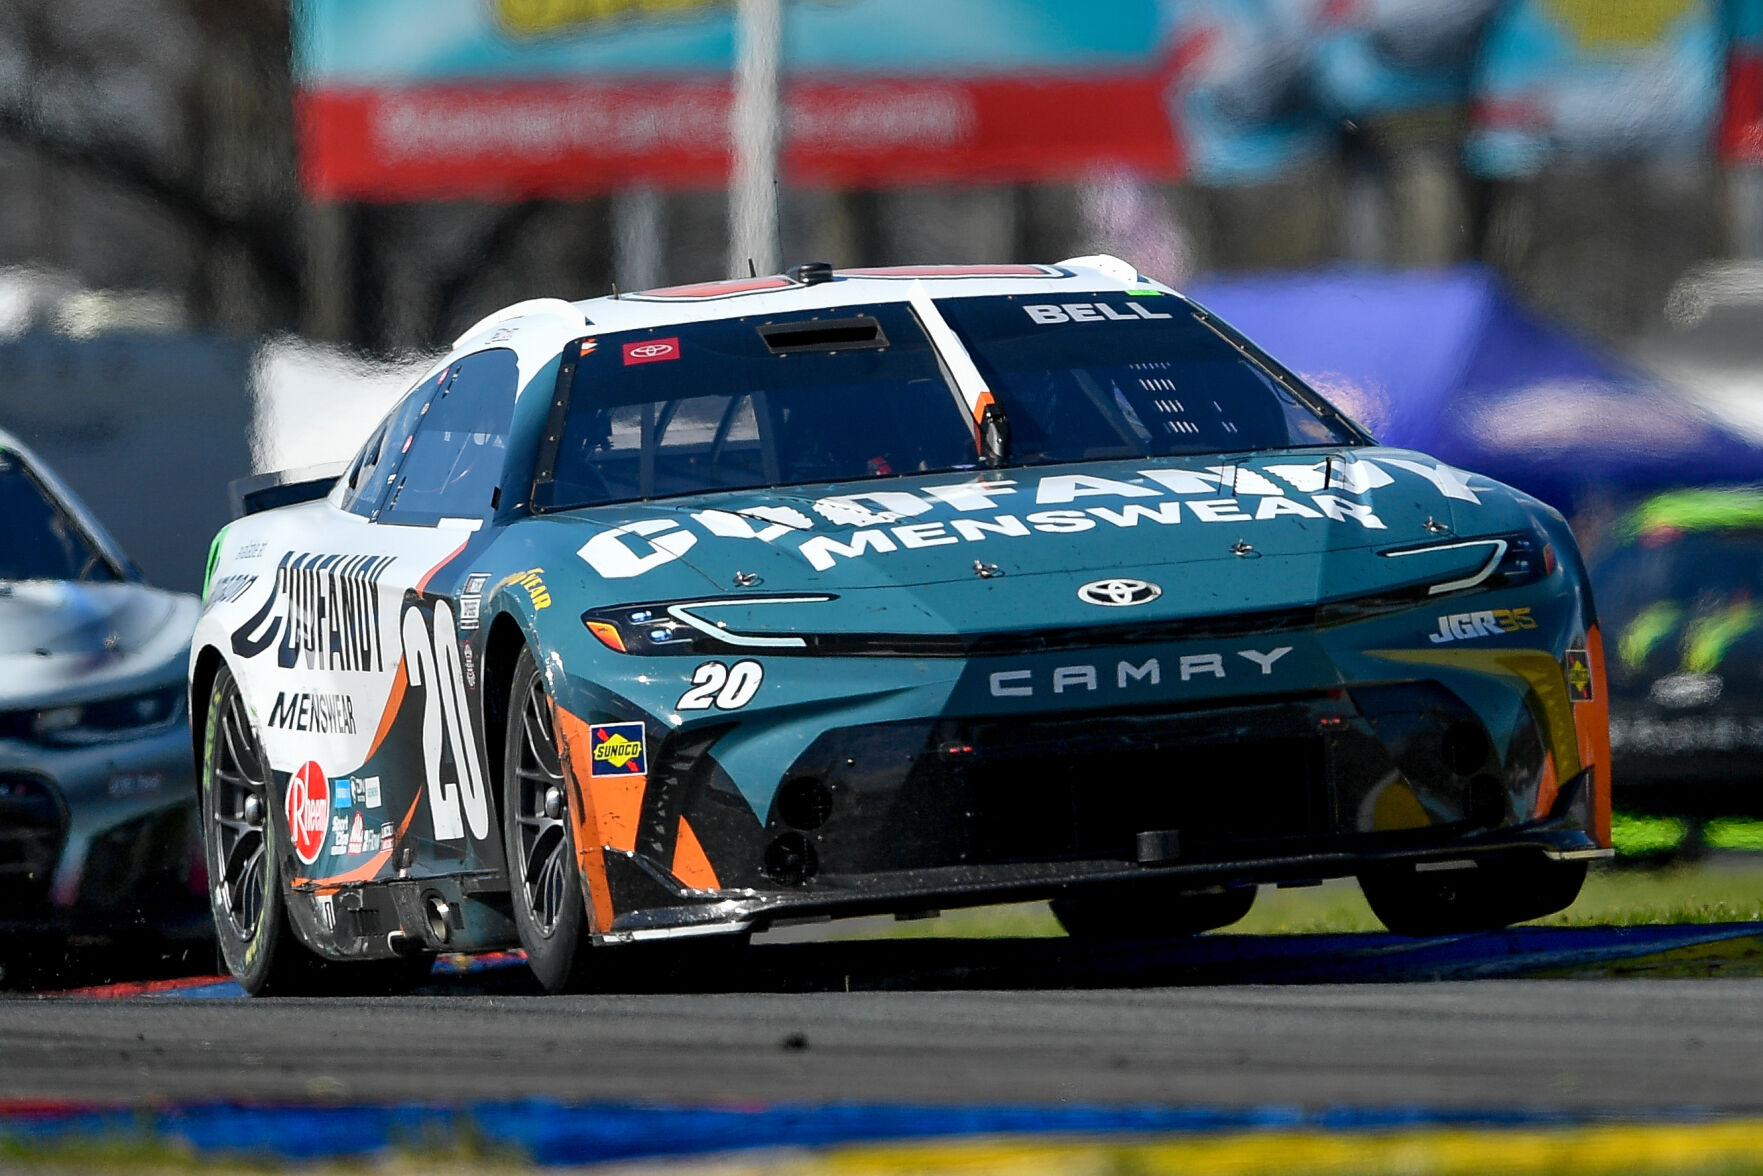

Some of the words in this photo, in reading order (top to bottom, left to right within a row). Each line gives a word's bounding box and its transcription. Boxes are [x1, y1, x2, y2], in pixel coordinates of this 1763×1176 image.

[1023, 302, 1173, 325] BELL
[799, 495, 1388, 572] MENSWEAR
[674, 660, 764, 711] 20
[989, 646, 1293, 697] CAMRY
[267, 691, 357, 735] MENSWEAR
[401, 599, 490, 841] 20
[596, 743, 640, 758] SUNOCO
[288, 761, 328, 847] Rheem
